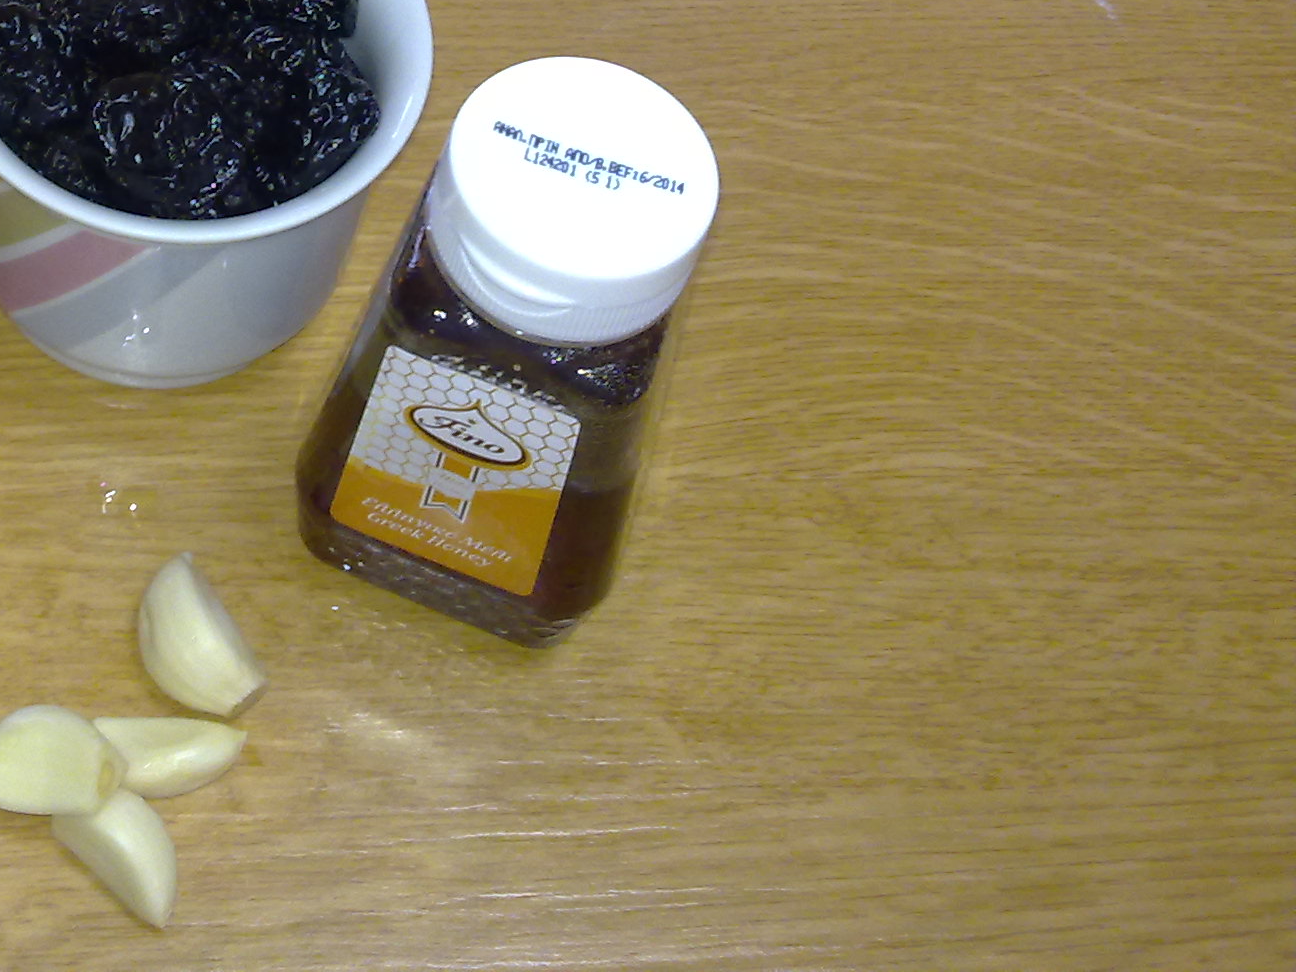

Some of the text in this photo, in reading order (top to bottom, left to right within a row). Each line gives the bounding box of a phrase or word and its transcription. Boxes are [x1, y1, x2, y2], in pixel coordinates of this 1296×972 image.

[418, 415, 505, 455] Fino
[366, 511, 494, 568] Greek Honey
